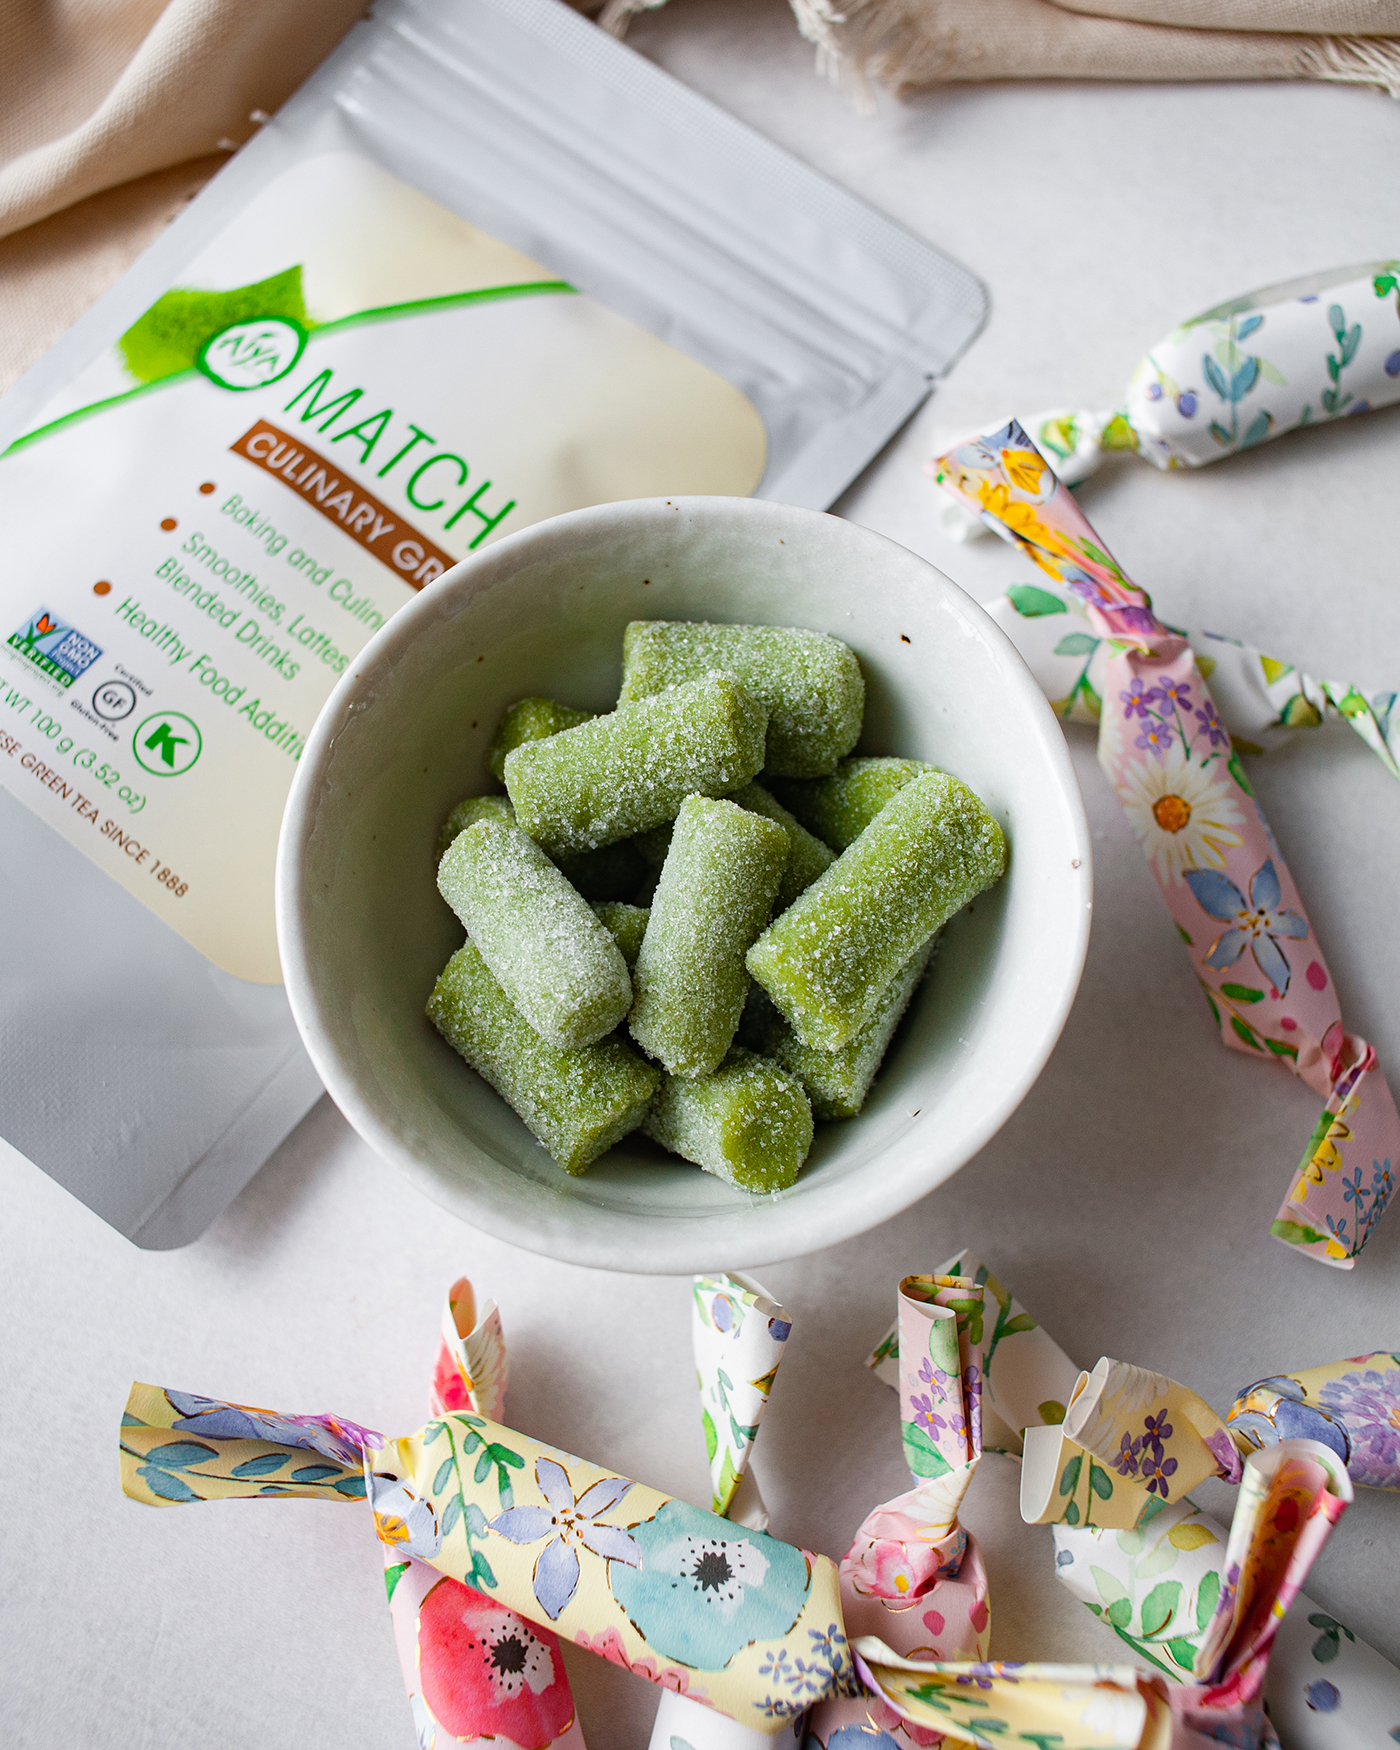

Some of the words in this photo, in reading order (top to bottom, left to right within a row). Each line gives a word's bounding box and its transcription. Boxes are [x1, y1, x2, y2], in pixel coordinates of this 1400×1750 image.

[246, 432, 395, 542] CULINARY
[283, 368, 516, 549] MATCH
[182, 532, 286, 626] Smoothies,
[220, 494, 289, 556] Baking
[287, 549, 334, 586] and
[328, 578, 388, 631] Culin
[11, 634, 73, 688] VERIFIED
[59, 641, 90, 669] GMO
[68, 633, 100, 660] NON
[115, 597, 193, 666] Healthy
[189, 654, 247, 706] Food
[155, 557, 242, 628] Blended
[235, 620, 301, 680] Drinks
[102, 689, 128, 709] GF
[114, 663, 154, 697] Certified
[5, 687, 33, 714] WT
[30, 708, 62, 739] 100
[56, 737, 75, 754] g
[73, 748, 120, 789] (3.52
[118, 786, 147, 814] oz)
[144, 722, 191, 768] K
[20, 753, 74, 801] GREEN
[70, 792, 101, 825] TEA
[100, 818, 150, 865] SINCE
[150, 859, 189, 898] 1888
